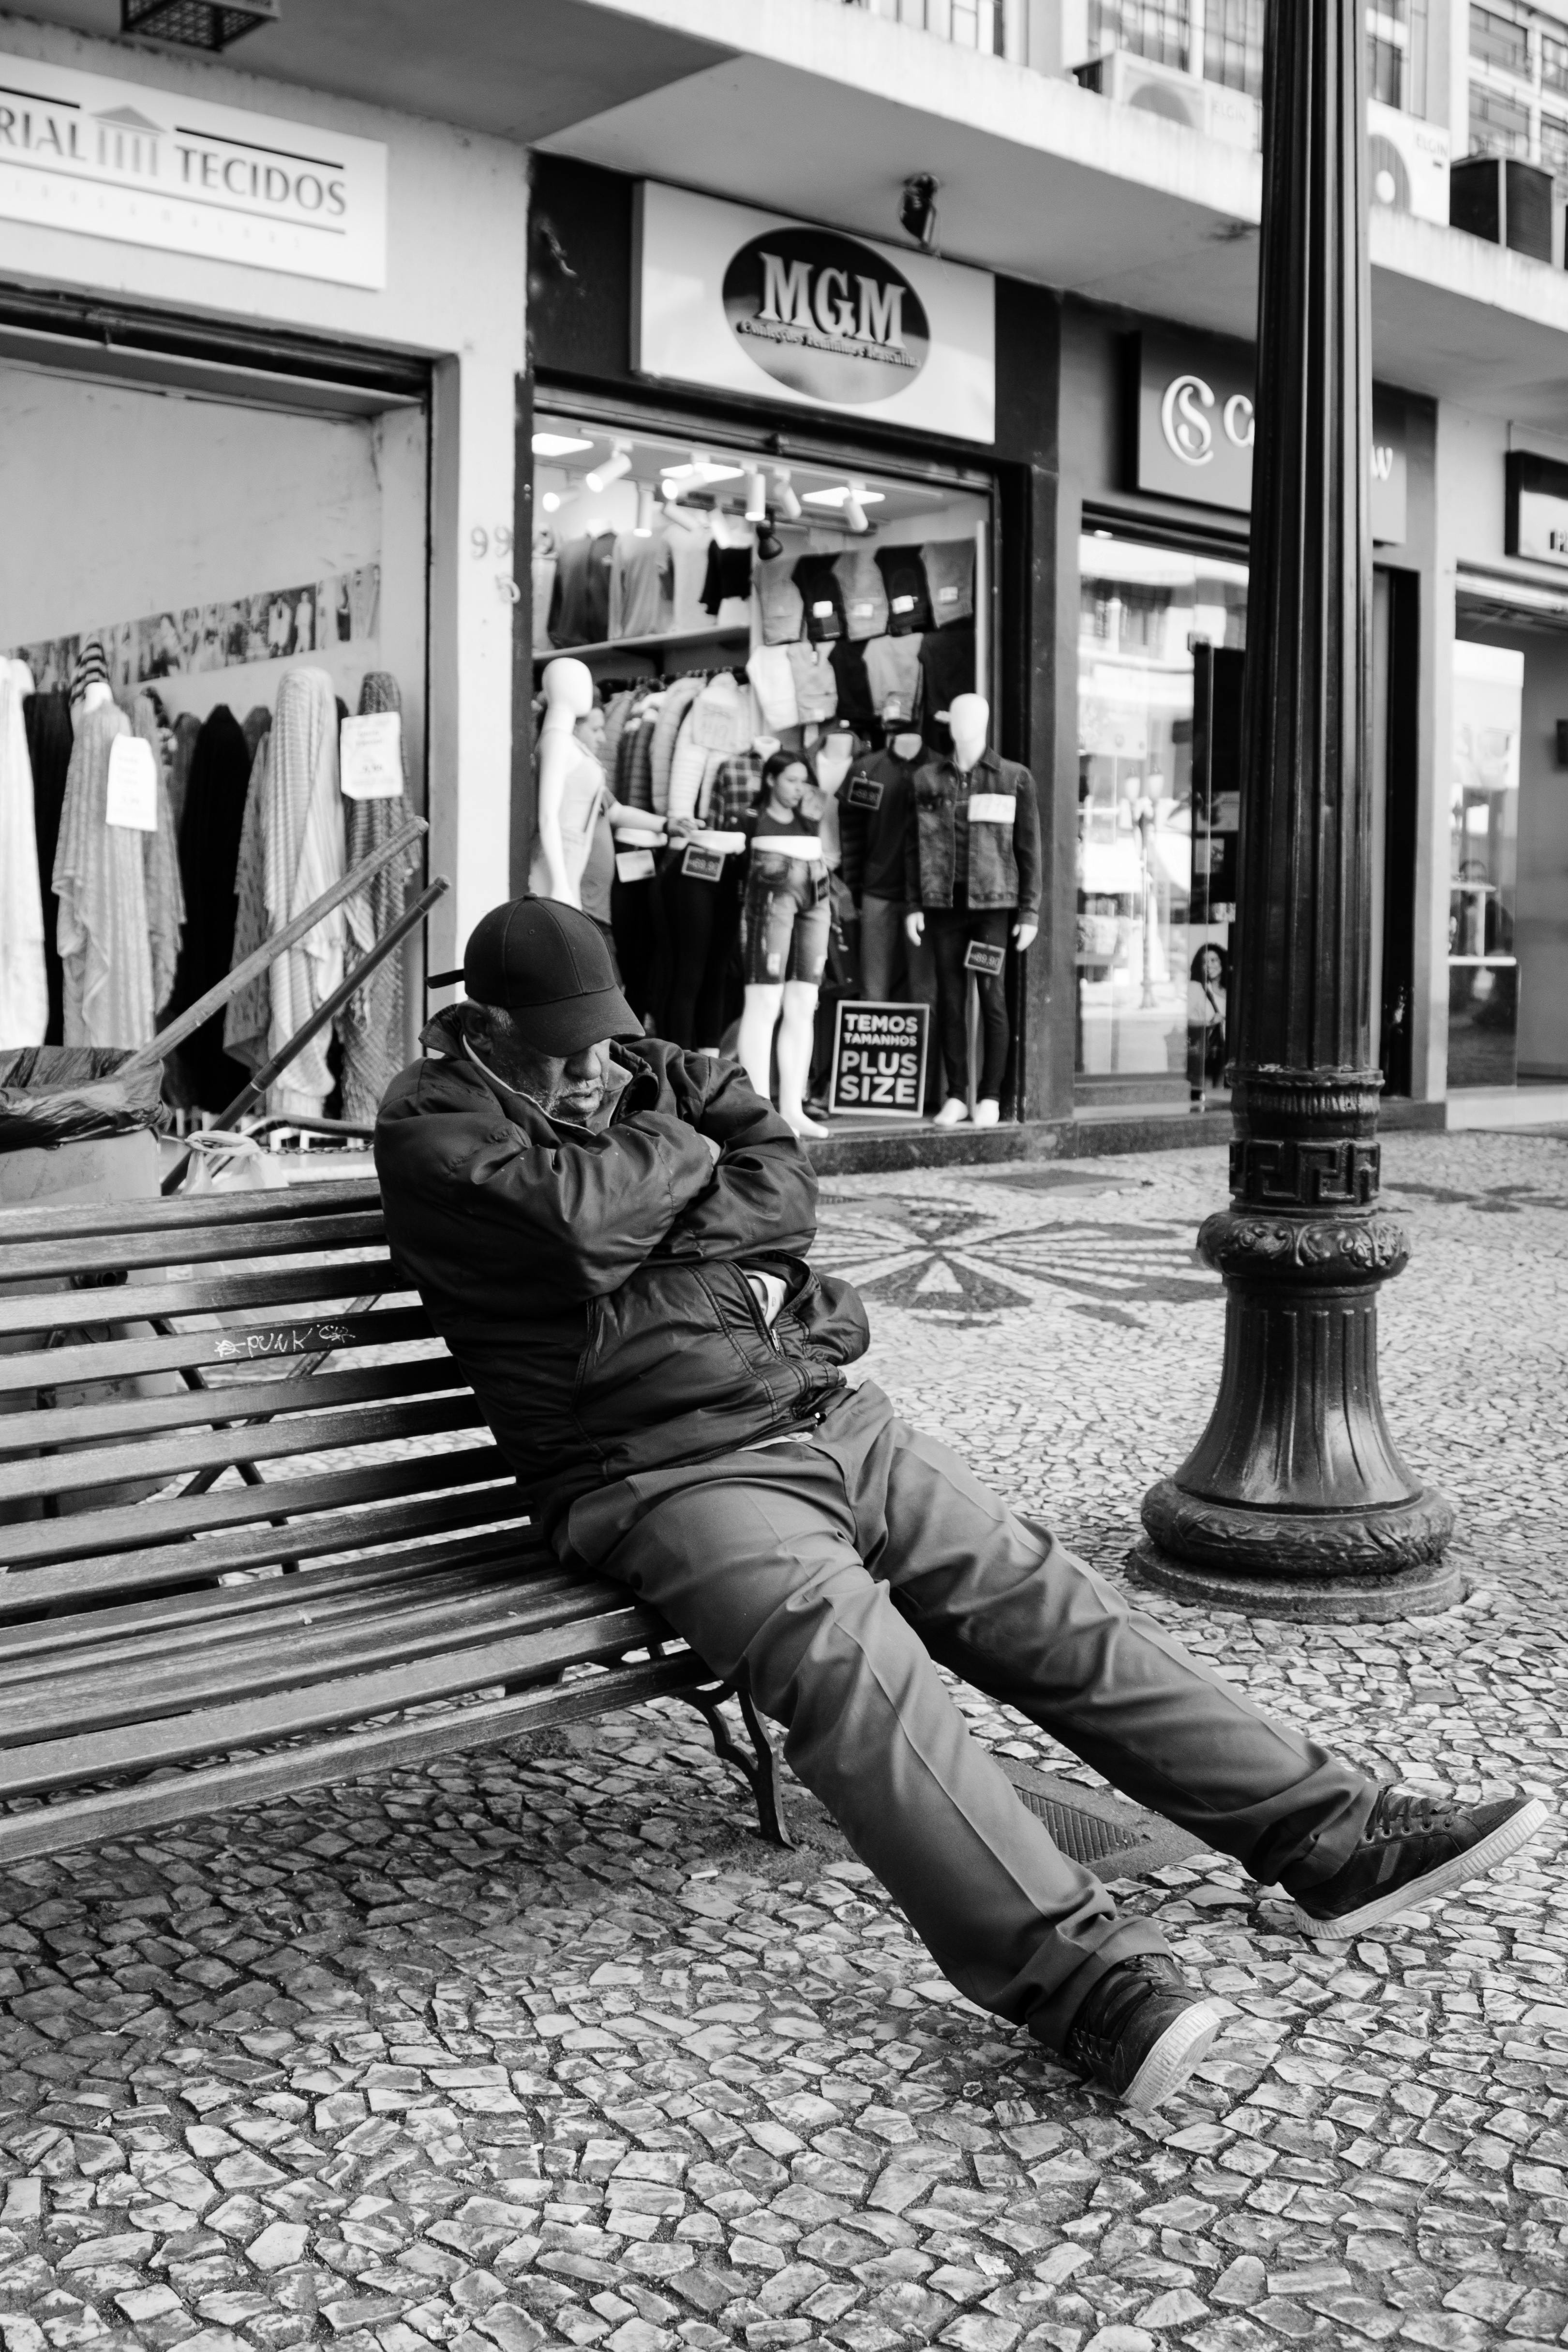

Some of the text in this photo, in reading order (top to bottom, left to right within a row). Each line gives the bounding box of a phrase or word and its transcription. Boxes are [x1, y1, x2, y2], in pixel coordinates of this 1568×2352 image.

[1213, 101, 1247, 124] ELGIN
[1416, 133, 1449, 157] ELGIN
[0, 106, 87, 162] RIAL
[174, 145, 346, 216] TECIDOS
[757, 251, 907, 349] MGM
[470, 525, 513, 561] 99
[844, 1013, 918, 1033] TEMOS
[843, 1032, 917, 1047] TAMANHOS
[840, 1050, 918, 1076] PLUS
[839, 1075, 917, 1104] SIZE
